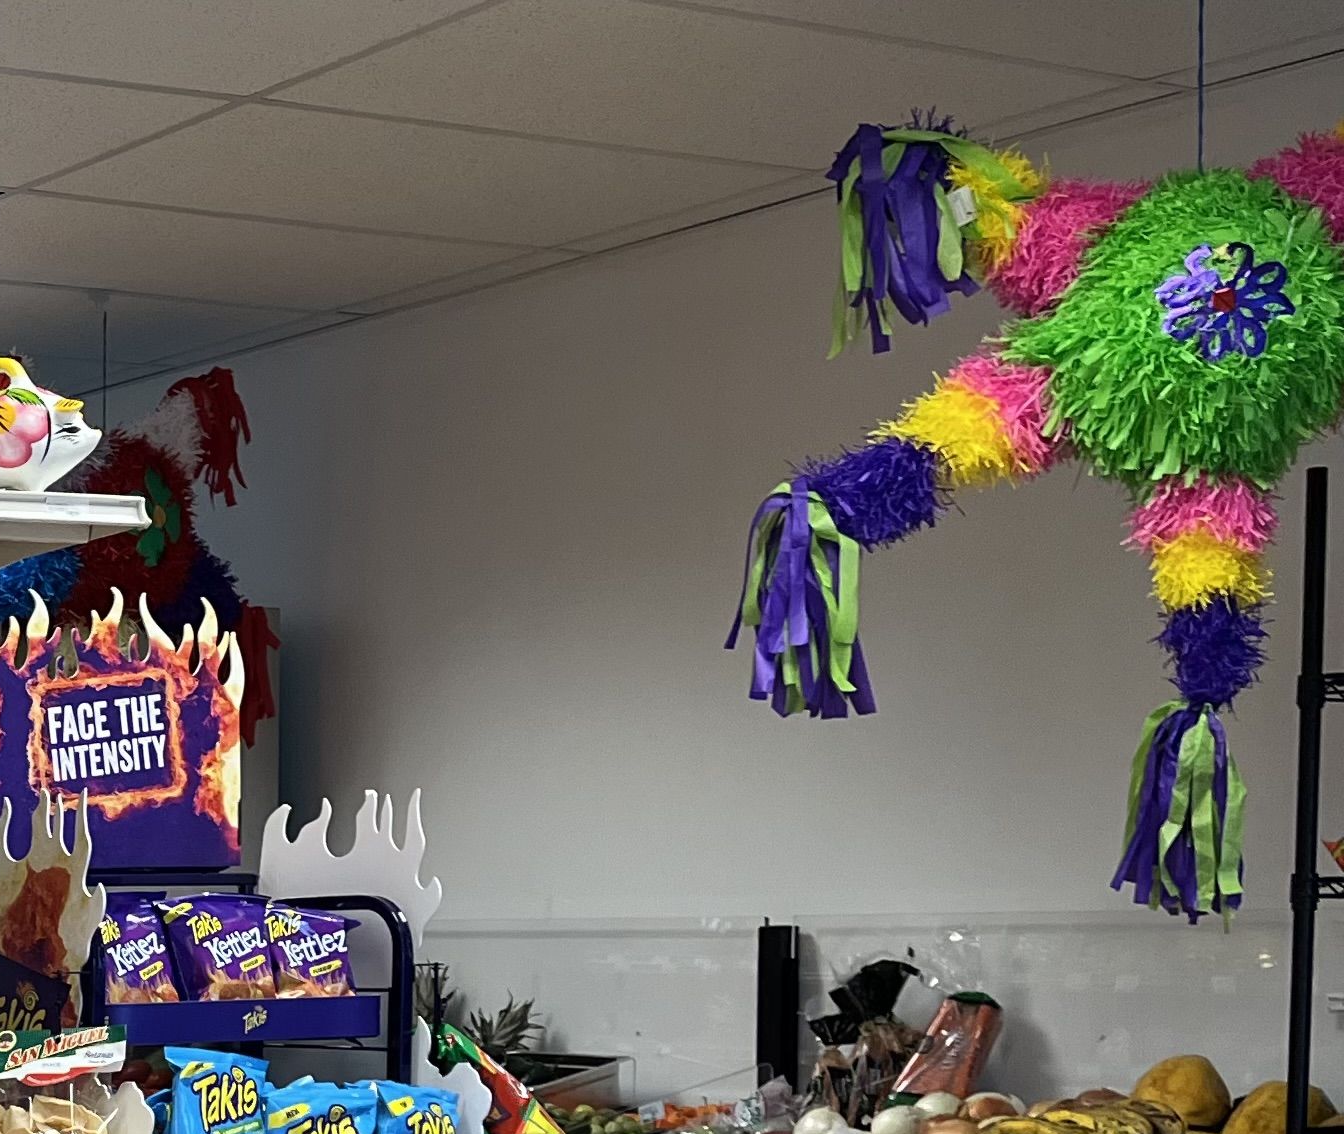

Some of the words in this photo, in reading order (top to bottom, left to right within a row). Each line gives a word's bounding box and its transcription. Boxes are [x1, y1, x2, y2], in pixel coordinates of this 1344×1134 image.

[48, 701, 111, 744] FACE
[114, 694, 164, 735] THE
[51, 734, 166, 782] INTENSITY
[100, 918, 120, 944] akis
[186, 911, 222, 944] Takis
[203, 926, 268, 969] Kettlez
[265, 911, 302, 943] Takis
[278, 929, 348, 967] Kettlez
[106, 932, 166, 976] Kettlez
[243, 1006, 268, 1034] Takis
[5, 1045, 41, 1070] SAN
[41, 1025, 110, 1058] MIGUEL
[193, 1066, 258, 1132] Takis
